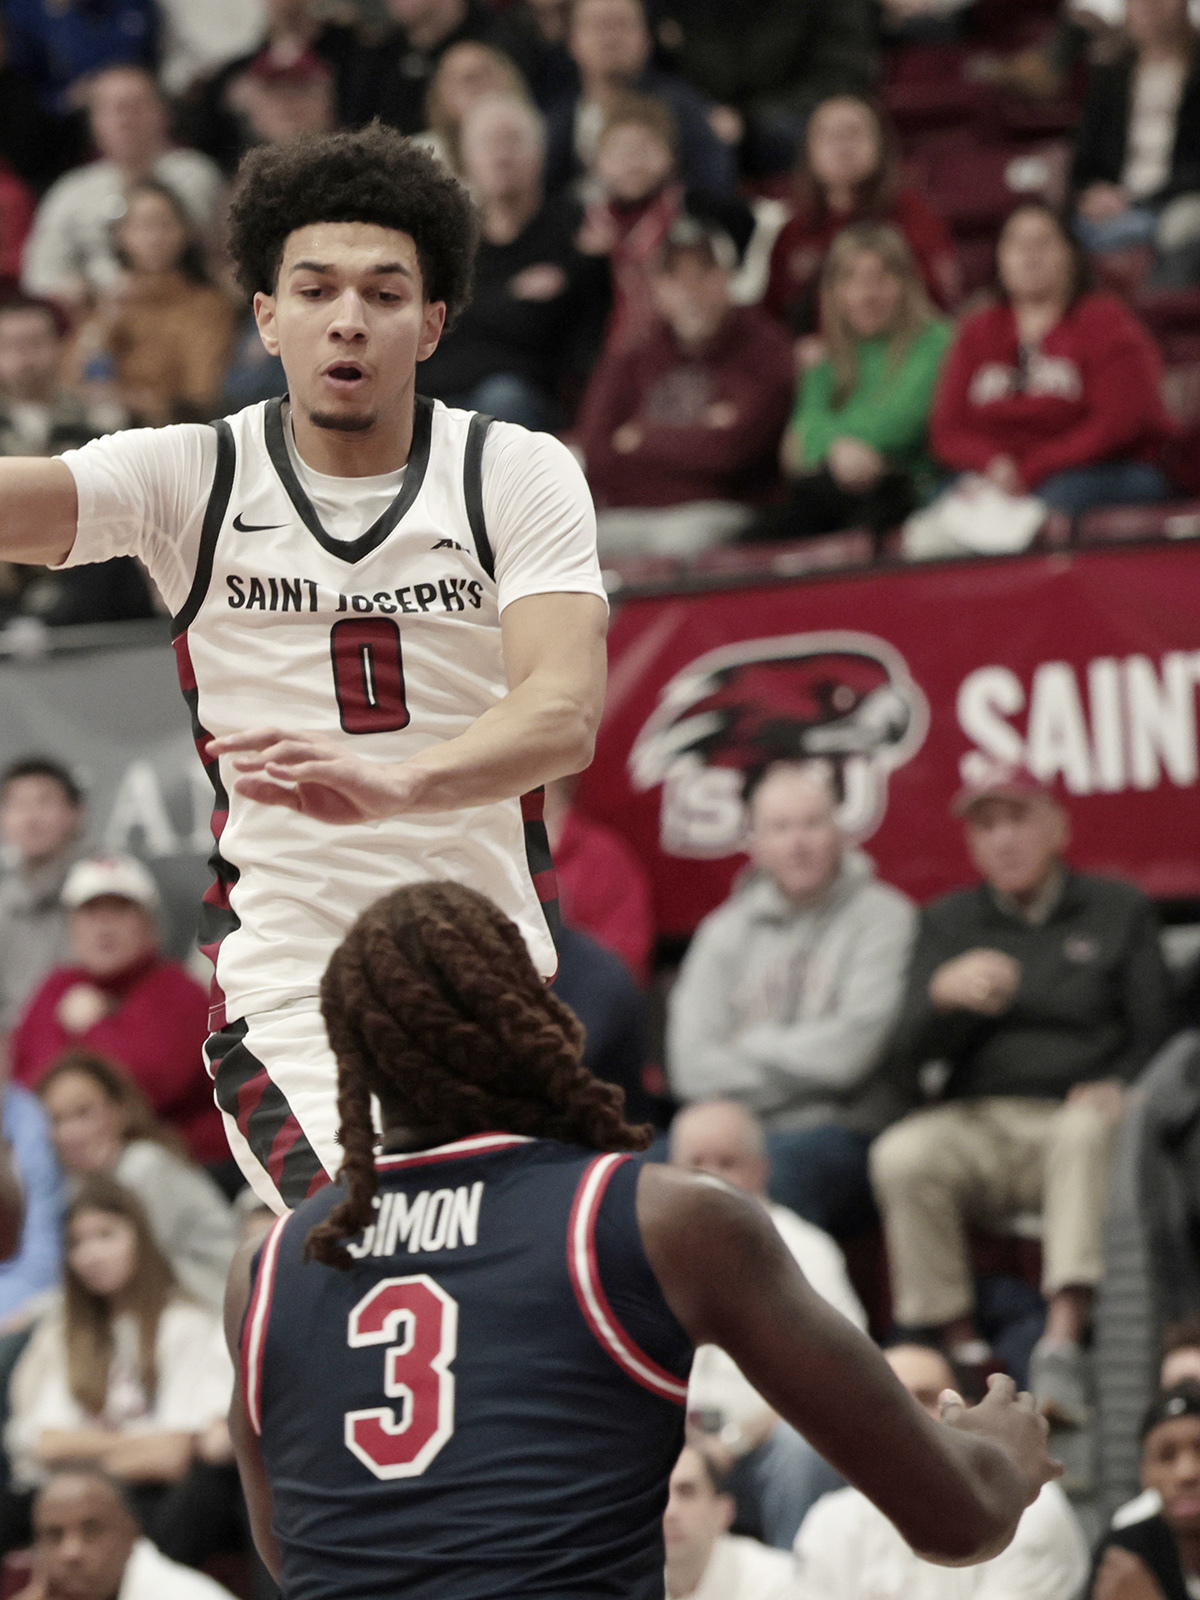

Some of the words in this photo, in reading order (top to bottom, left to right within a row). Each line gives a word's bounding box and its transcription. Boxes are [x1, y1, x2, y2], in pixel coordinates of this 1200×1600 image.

[226, 574, 320, 612] SAINT
[330, 616, 410, 735] 0
[955, 650, 1200, 797] SAIN
[344, 1273, 459, 1481] 3
